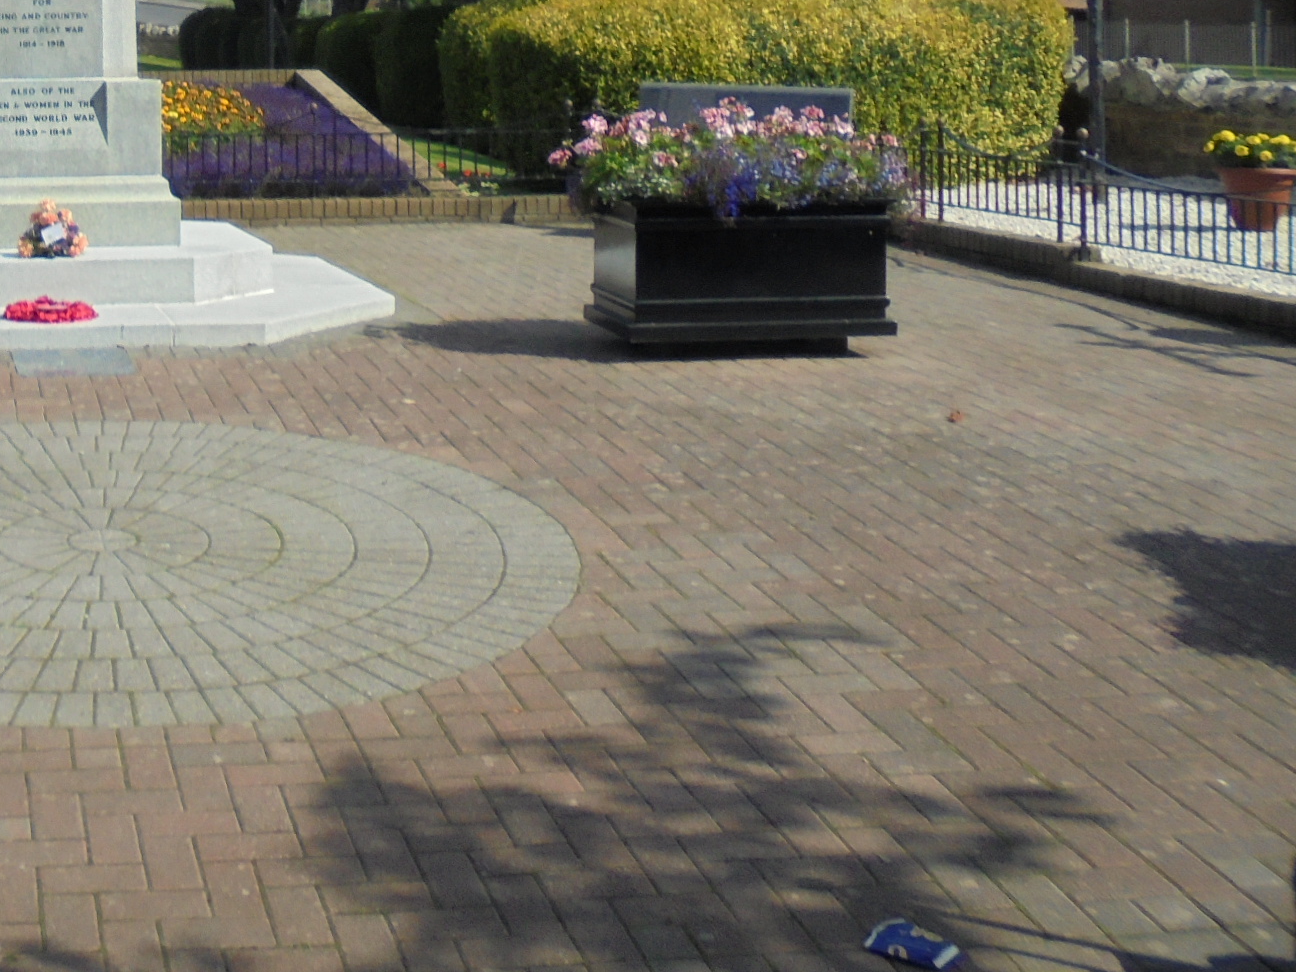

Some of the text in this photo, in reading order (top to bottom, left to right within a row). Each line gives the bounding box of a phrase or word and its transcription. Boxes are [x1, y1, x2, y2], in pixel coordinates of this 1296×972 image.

[0, 26, 83, 34] IN THE GREAT WAR
[25, 101, 59, 109] WOMEN
[64, 101, 73, 109] IN
[78, 101, 94, 109] THE
[15, 128, 38, 136] 1939
[49, 128, 72, 136] 1945
